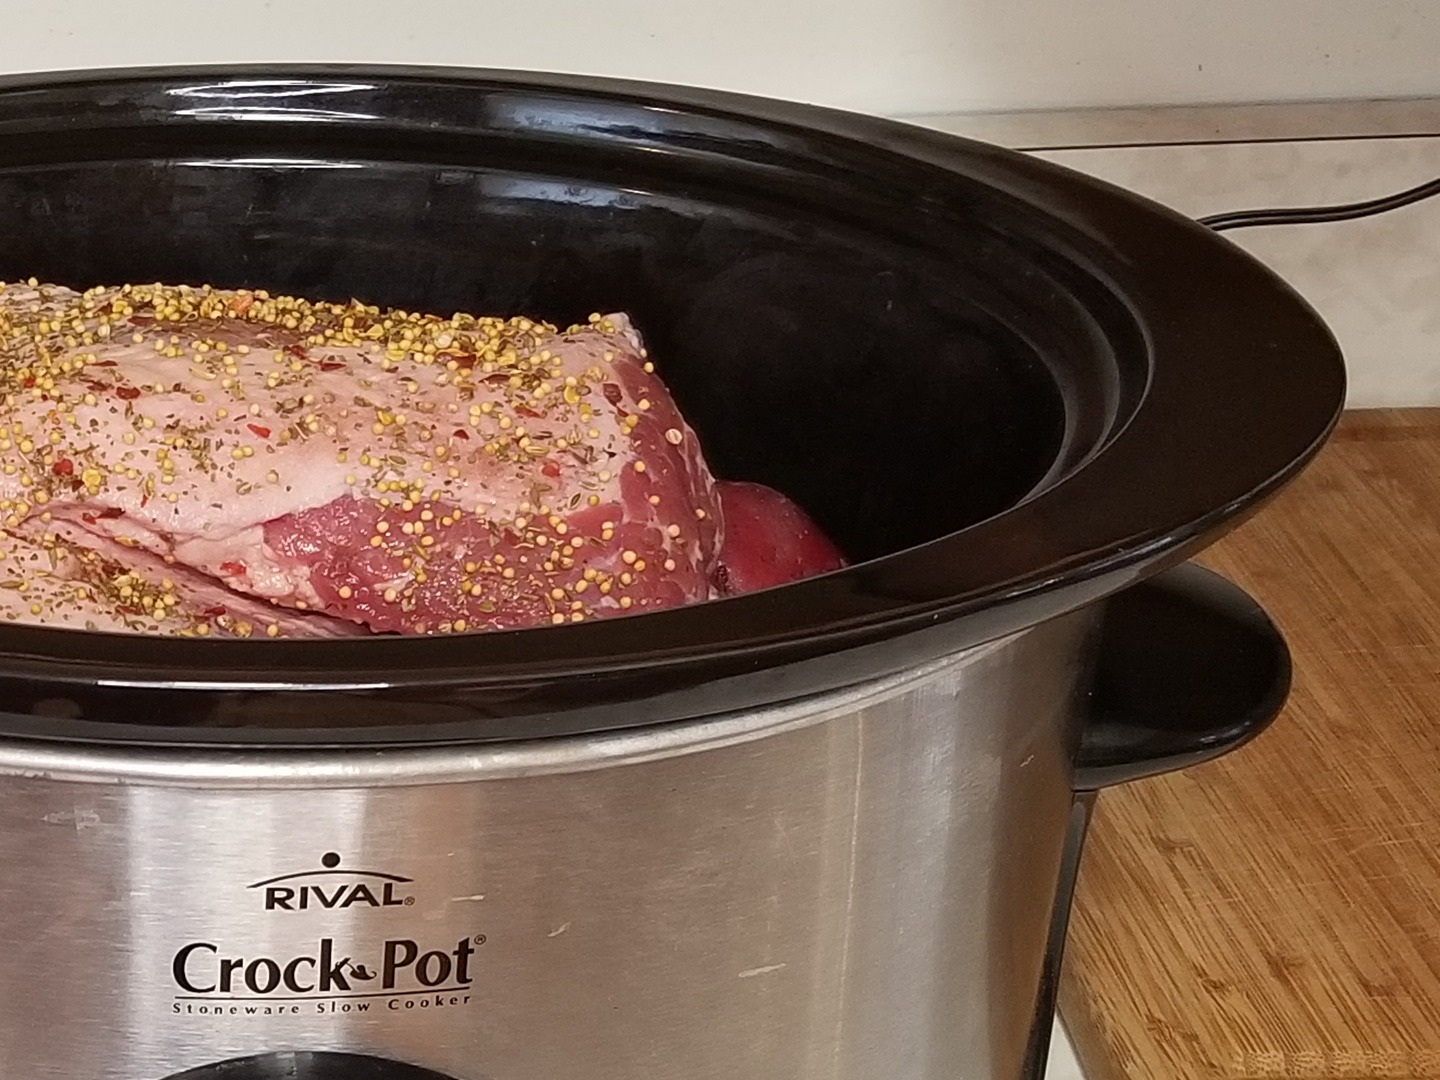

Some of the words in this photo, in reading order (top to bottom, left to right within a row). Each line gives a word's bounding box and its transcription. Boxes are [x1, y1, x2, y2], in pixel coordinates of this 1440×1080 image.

[264, 882, 404, 911] RIVAL
[172, 1002, 300, 1016] Stoneware
[317, 1001, 371, 1013] Slow
[388, 994, 472, 1011] Cooker
